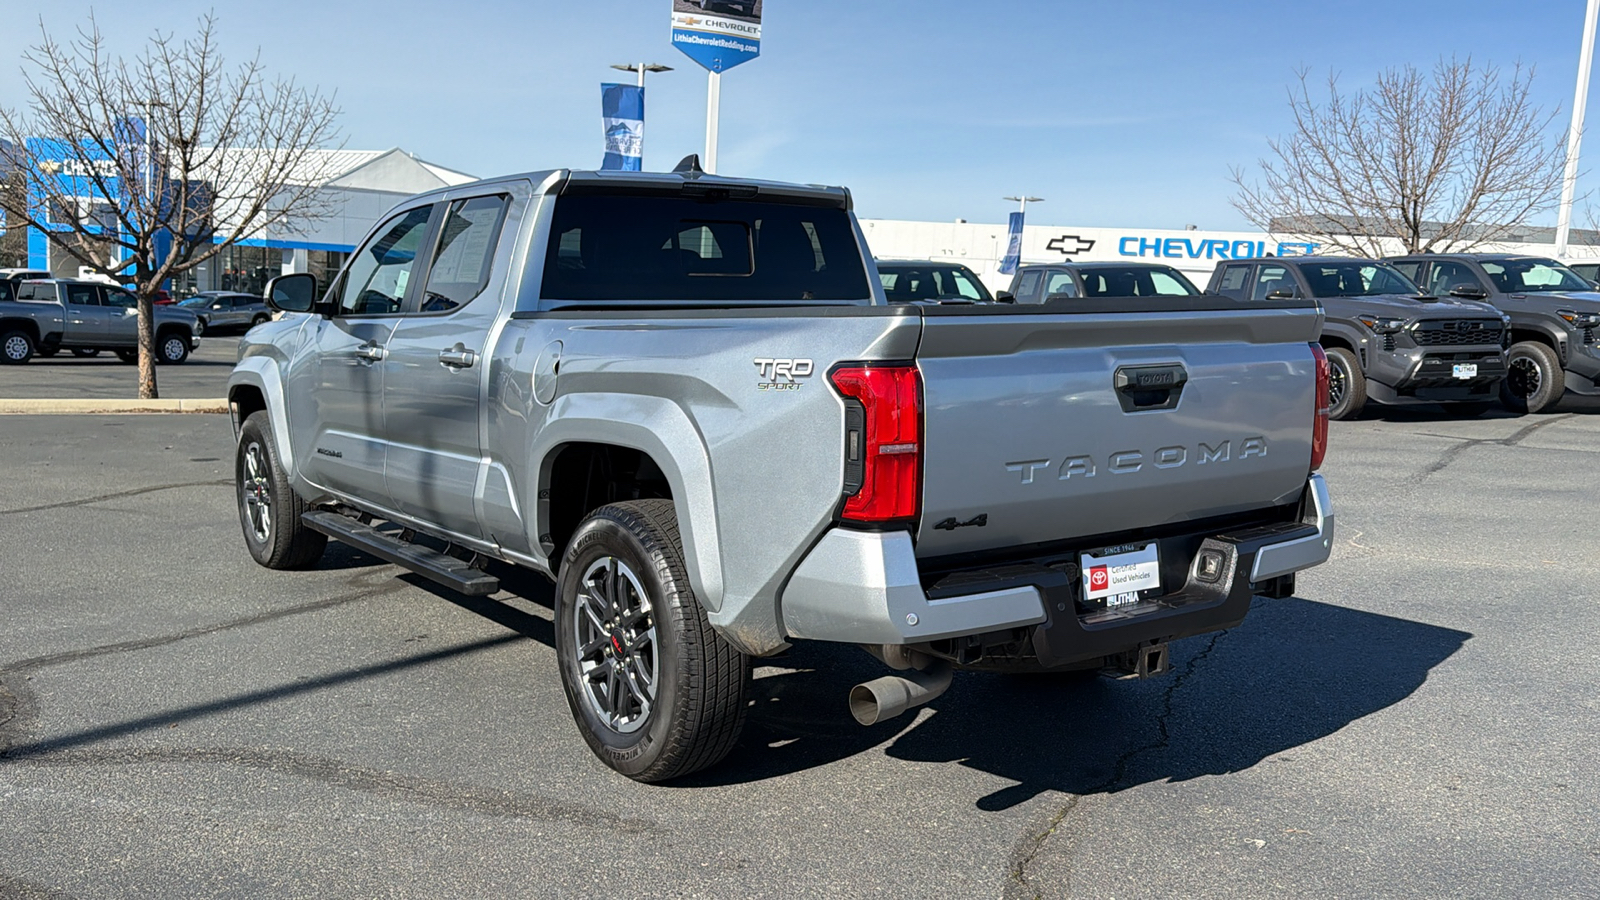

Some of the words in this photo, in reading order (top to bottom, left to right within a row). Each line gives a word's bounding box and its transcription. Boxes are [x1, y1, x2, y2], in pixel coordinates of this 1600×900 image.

[705, 19, 759, 34] CHEVROLET
[674, 33, 758, 53] LithiaChevroletRedding.com
[1119, 237, 1320, 260] CHEVROLET
[754, 358, 814, 381] TRD
[1138, 373, 1172, 385] TOYOTA
[757, 382, 804, 392] SPORT
[1004, 436, 1268, 485] TACOMA
[1104, 546, 1120, 554] SINCE
[1111, 563, 1137, 574] Certified
[1113, 575, 1127, 584] Used
[1127, 571, 1151, 582] Vehicles
[1114, 591, 1139, 605] LITHIA
